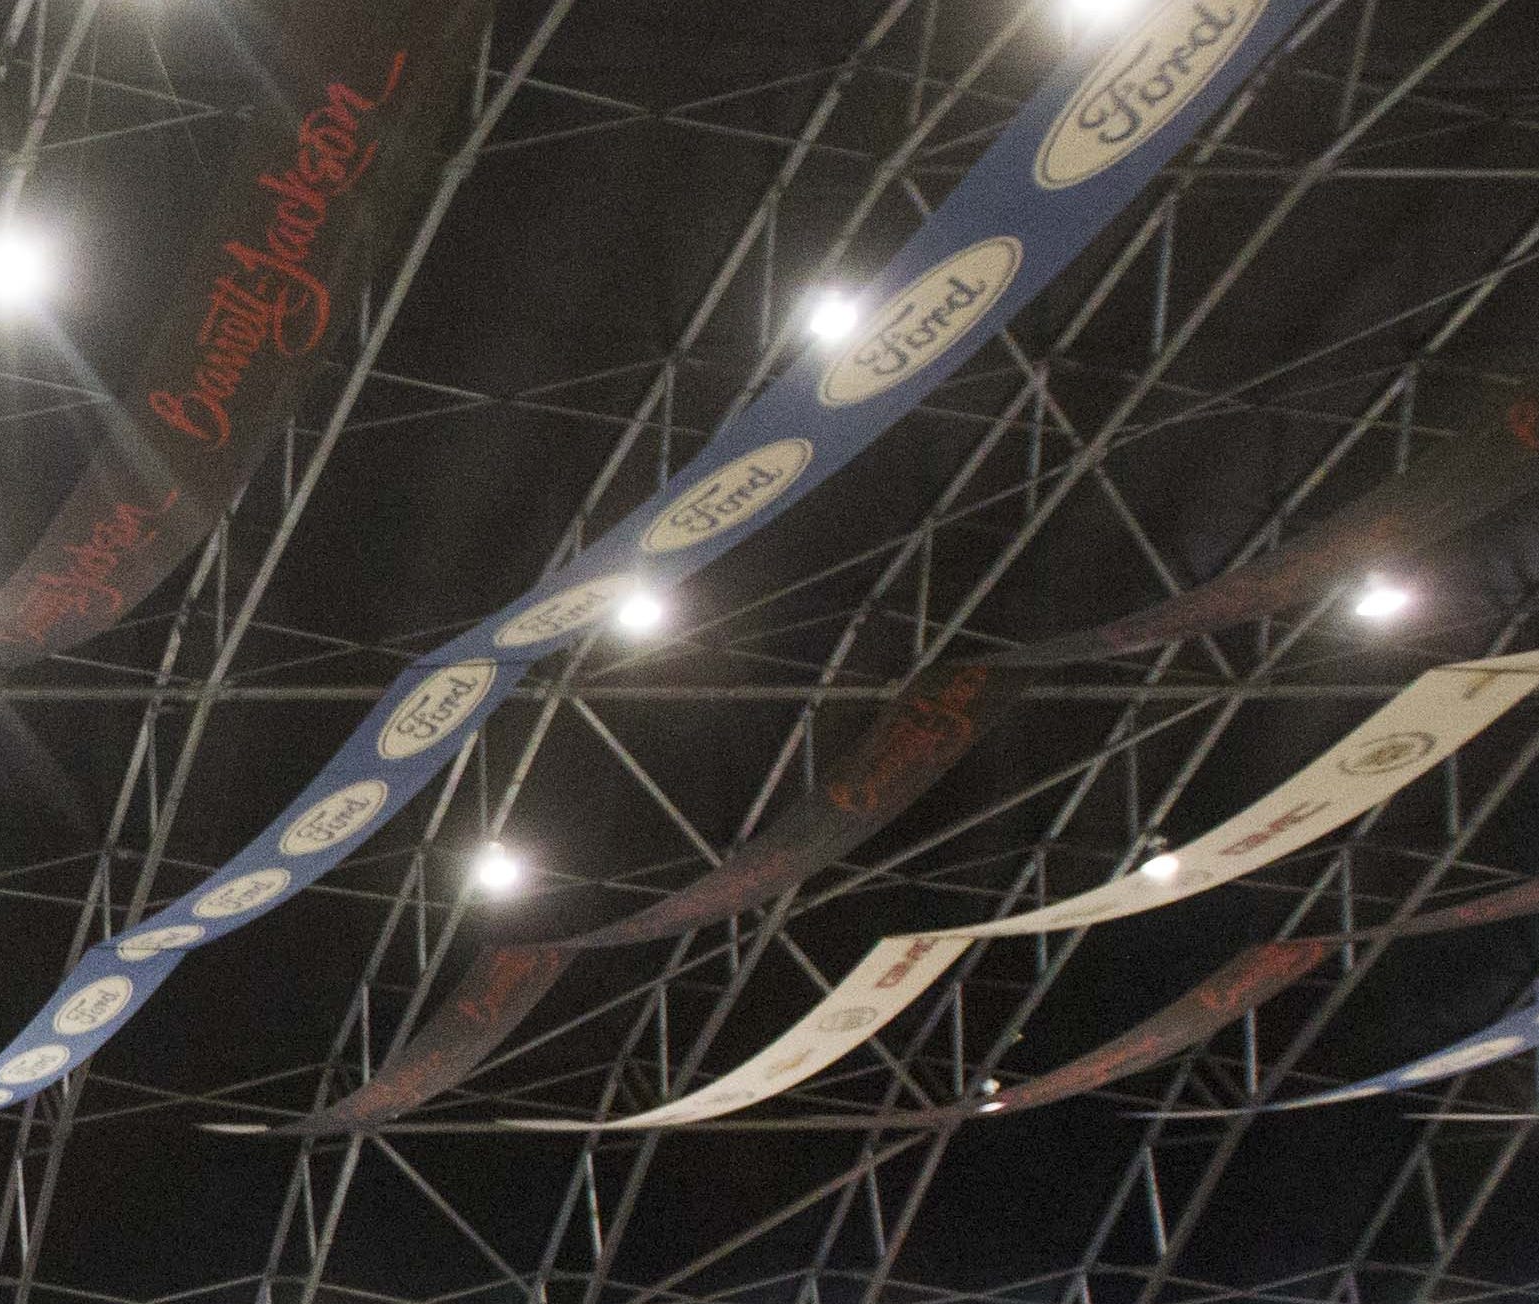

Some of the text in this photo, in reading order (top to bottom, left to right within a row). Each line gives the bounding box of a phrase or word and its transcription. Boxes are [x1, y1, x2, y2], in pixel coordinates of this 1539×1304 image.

[1080, 5, 1235, 143] Ford
[148, 51, 406, 445] Barrett-Jackson
[856, 278, 986, 375] Ford
[671, 468, 783, 532] Ford
[397, 674, 478, 737] Ford
[299, 800, 369, 844] Ford
